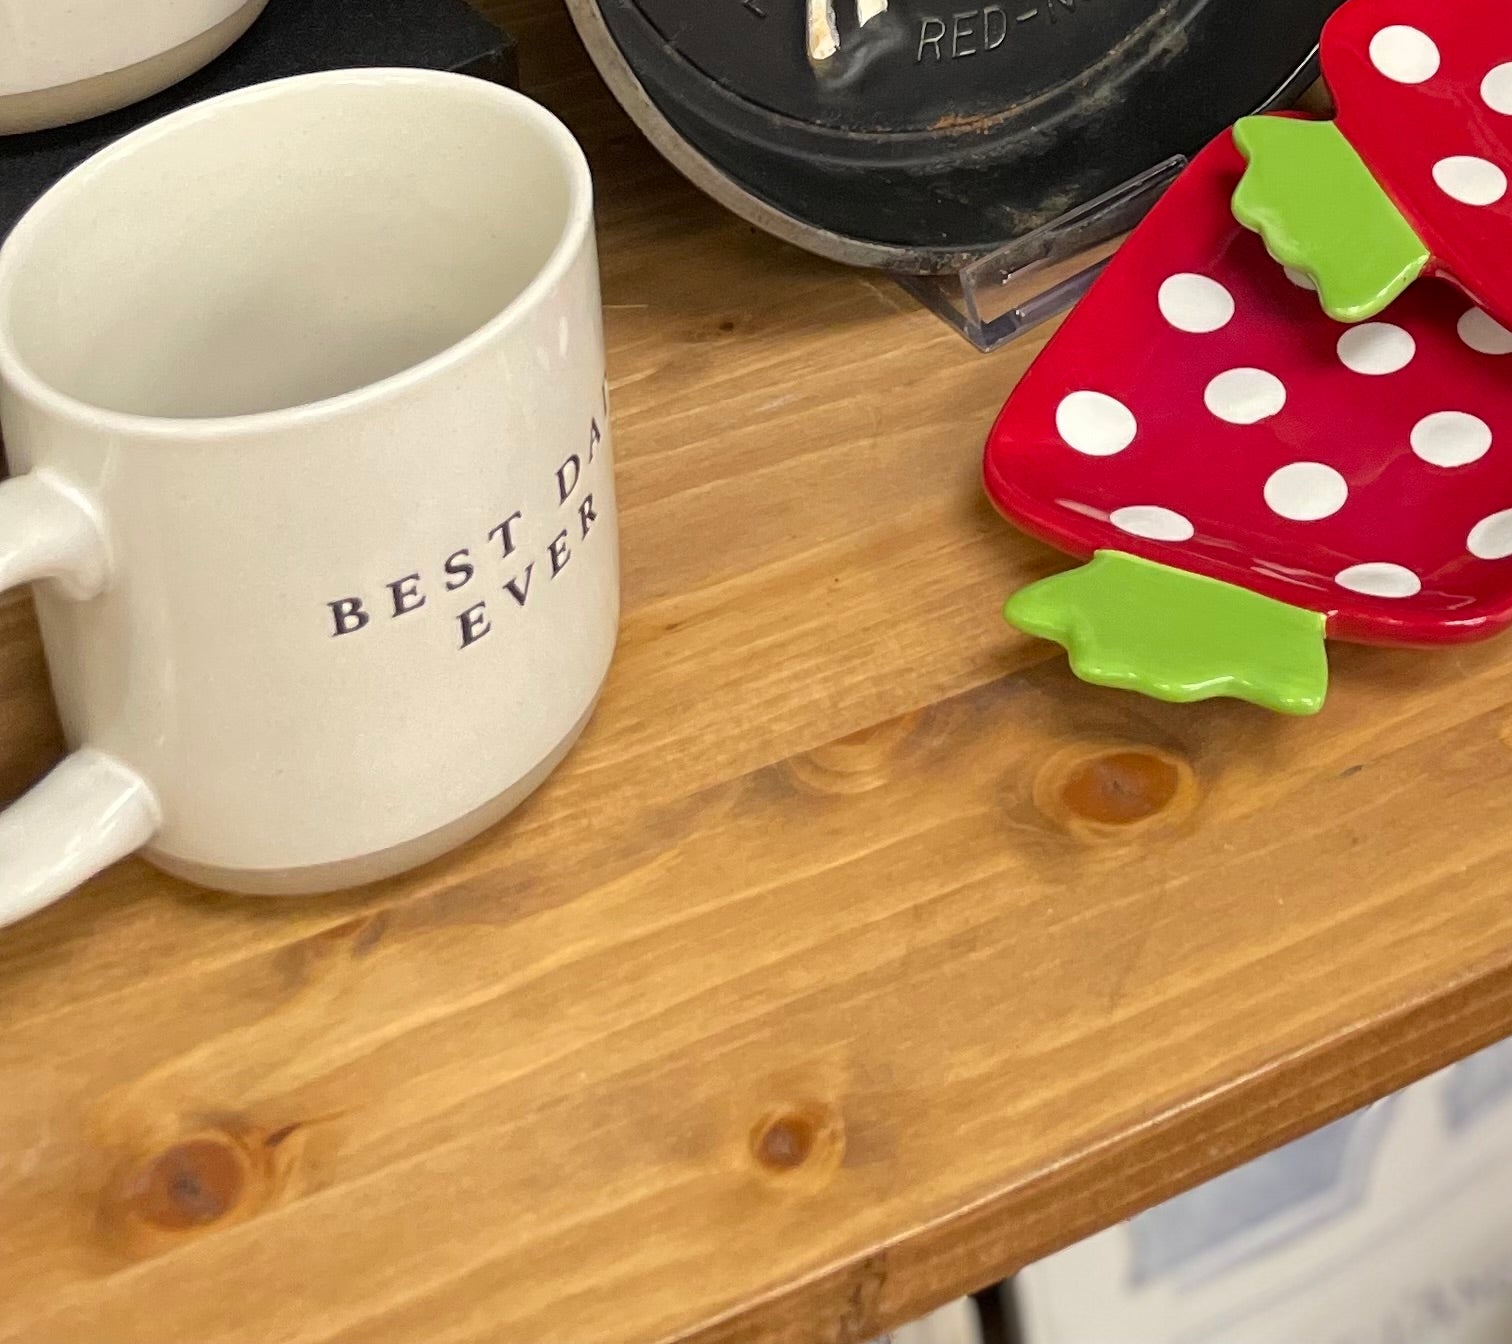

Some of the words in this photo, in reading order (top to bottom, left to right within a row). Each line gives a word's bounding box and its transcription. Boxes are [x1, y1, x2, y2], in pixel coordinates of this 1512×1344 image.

[326, 510, 522, 638] BEST
[554, 372, 608, 506] DA
[455, 492, 598, 651] EVER
